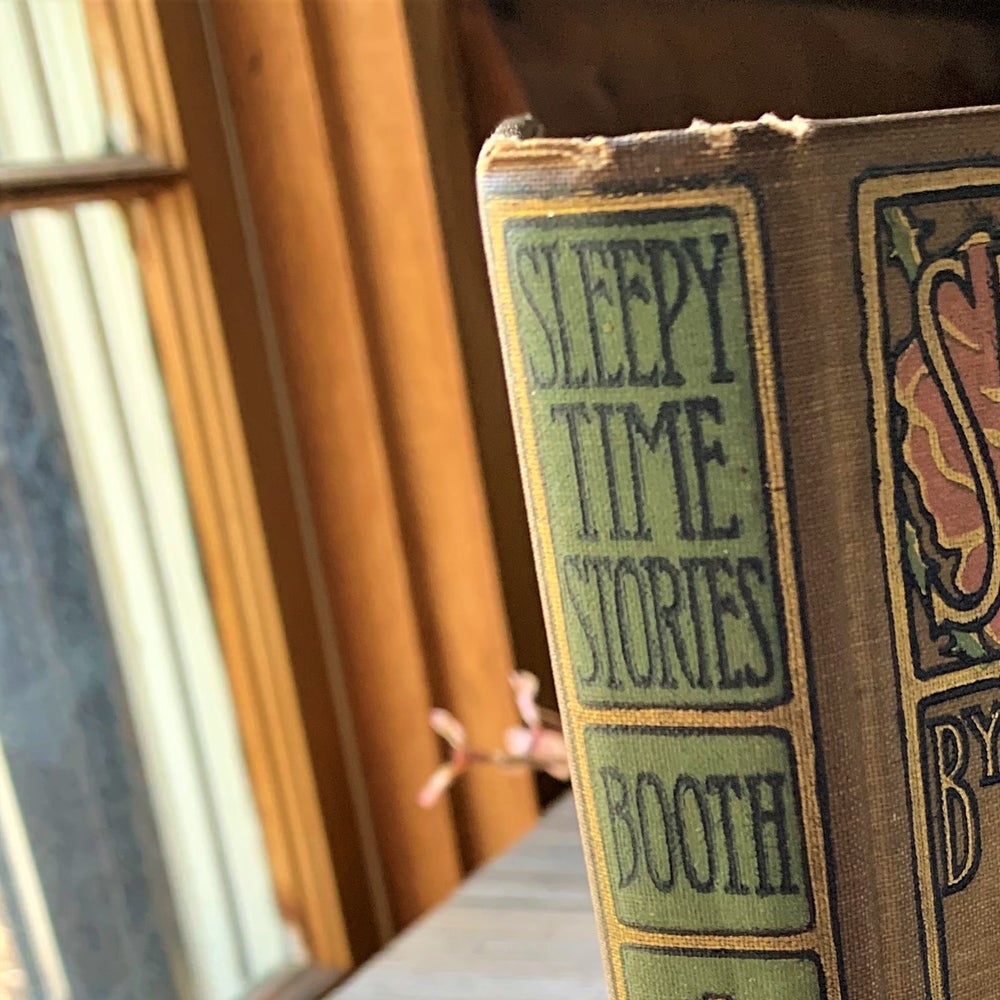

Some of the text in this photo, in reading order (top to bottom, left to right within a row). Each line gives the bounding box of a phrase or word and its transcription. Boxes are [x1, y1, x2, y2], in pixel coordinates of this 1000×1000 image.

[514, 233, 736, 392] SLEEPY
[551, 396, 742, 543] TIME
[563, 553, 776, 693] STORIES
[600, 764, 800, 898] BOOTH
